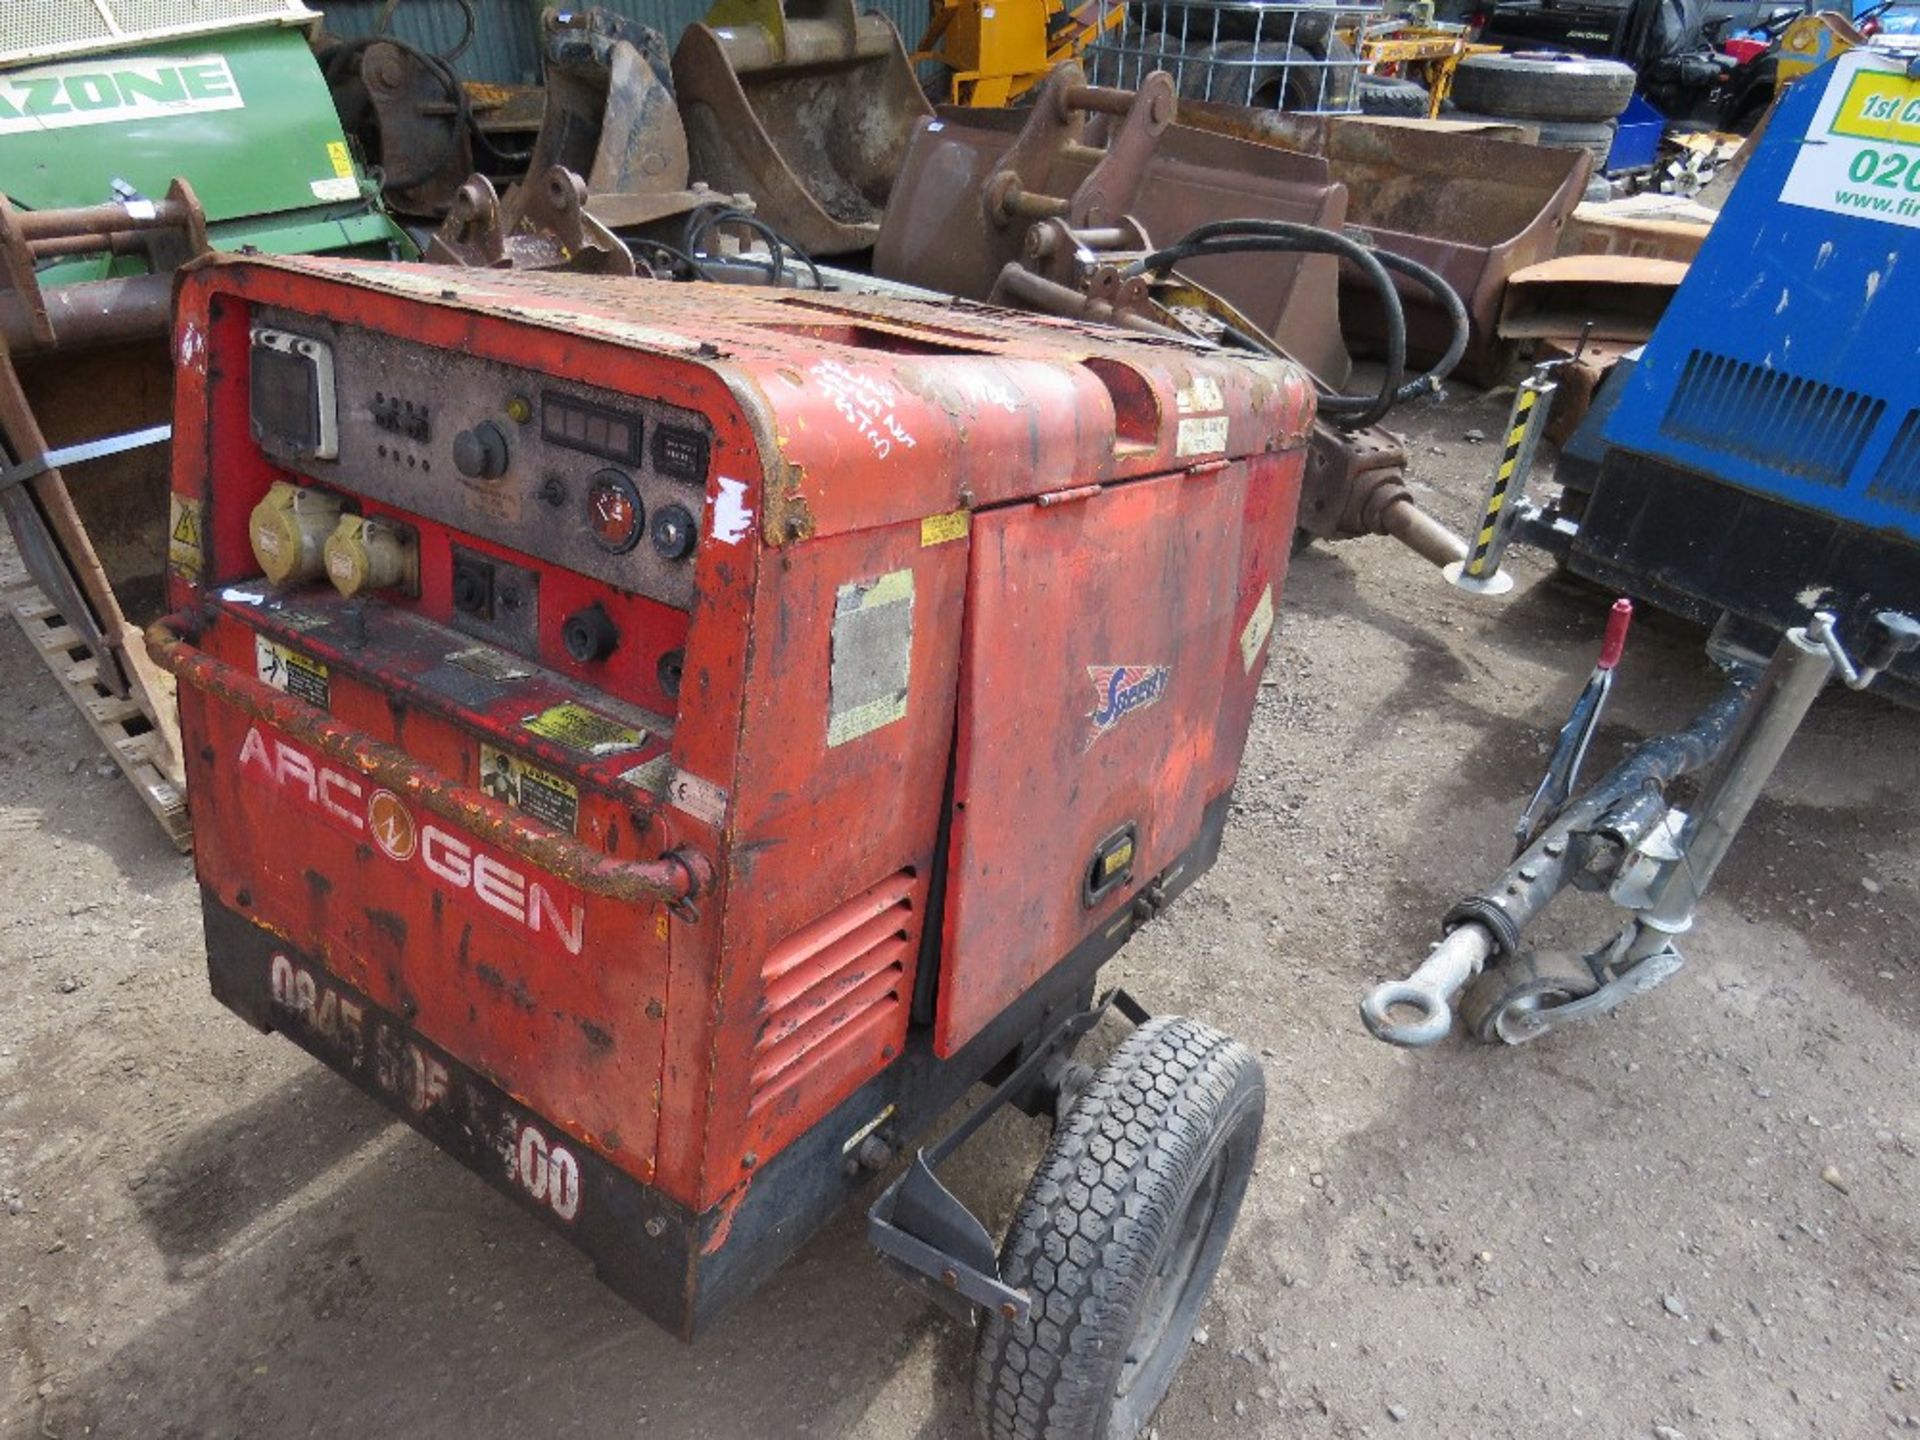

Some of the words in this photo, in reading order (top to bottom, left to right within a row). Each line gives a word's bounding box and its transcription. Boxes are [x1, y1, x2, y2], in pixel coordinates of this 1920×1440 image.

[1863, 95, 1900, 120] 1st
[1901, 99, 1920, 123] C
[421, 824, 584, 956] GEN
